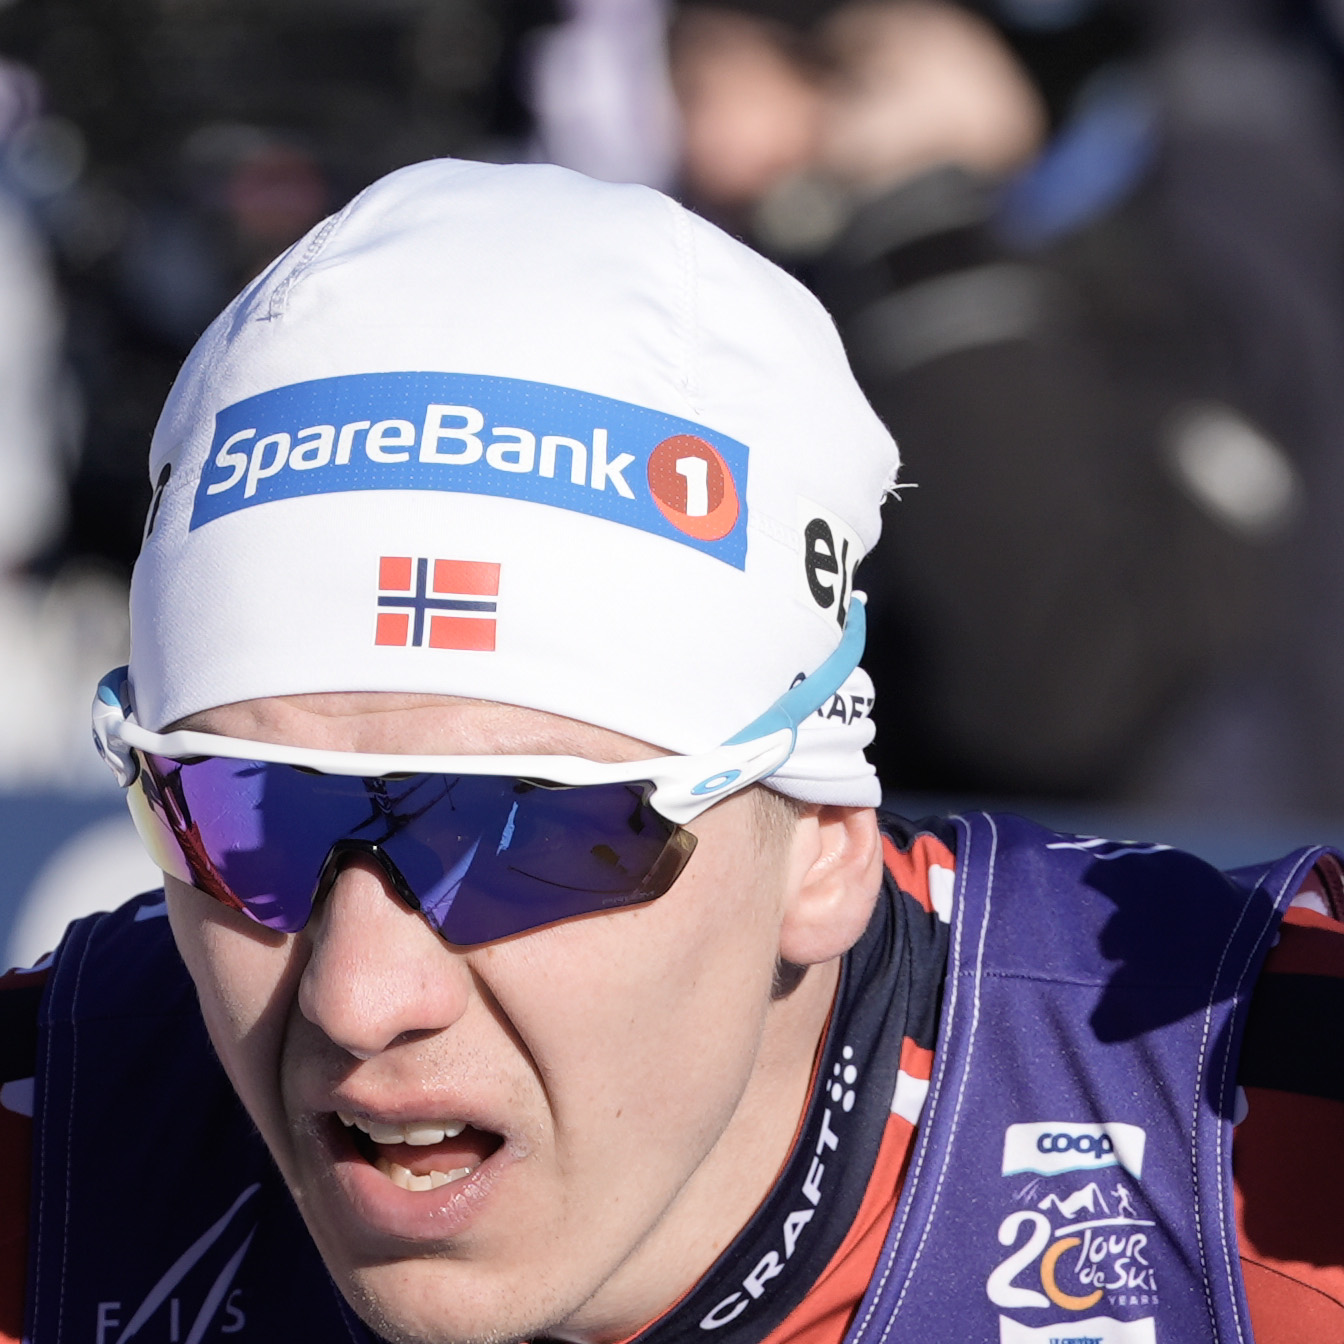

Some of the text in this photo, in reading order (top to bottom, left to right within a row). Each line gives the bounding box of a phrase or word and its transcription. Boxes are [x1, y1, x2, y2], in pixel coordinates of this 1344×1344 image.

[207, 404, 709, 517] SpareBank 1
[1037, 1132, 1114, 1159] coop
[699, 1107, 839, 1330] CRAFT
[1107, 1295, 1159, 1306] YEARS
